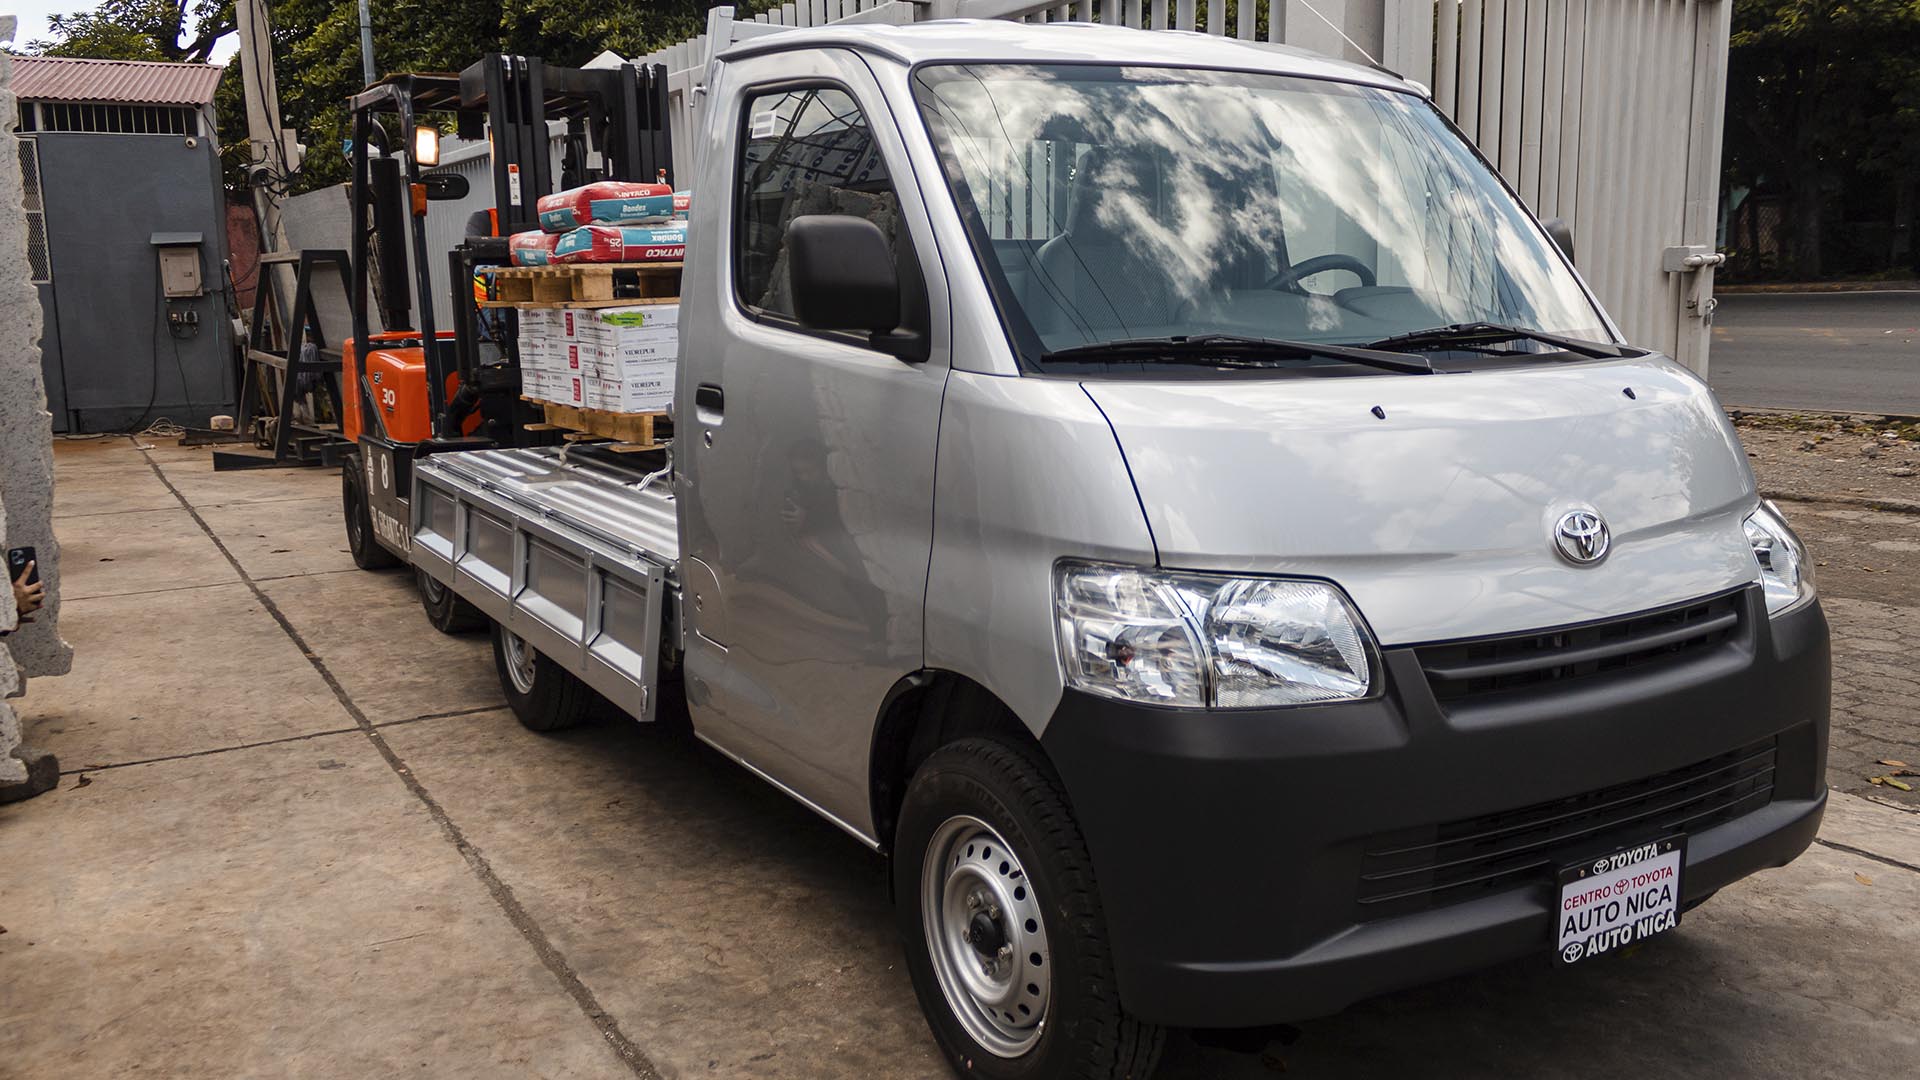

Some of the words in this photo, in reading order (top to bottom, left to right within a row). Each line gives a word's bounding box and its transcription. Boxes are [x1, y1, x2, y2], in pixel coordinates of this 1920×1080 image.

[621, 190, 650, 198] INTACO
[622, 204, 647, 213] Bondex
[609, 238, 622, 248] 25
[651, 232, 684, 243] Bondex
[645, 248, 686, 258] INTACO
[382, 388, 396, 406] 30
[380, 453, 389, 489] 8
[1610, 843, 1658, 871] TOYOTA
[1564, 886, 1612, 911] CENTRO
[1631, 866, 1673, 889] TOYOTA
[1562, 901, 1620, 938] AUTO
[1626, 884, 1672, 917] NICA
[1586, 926, 1632, 957] AUTO
[1637, 911, 1676, 940] NICA
